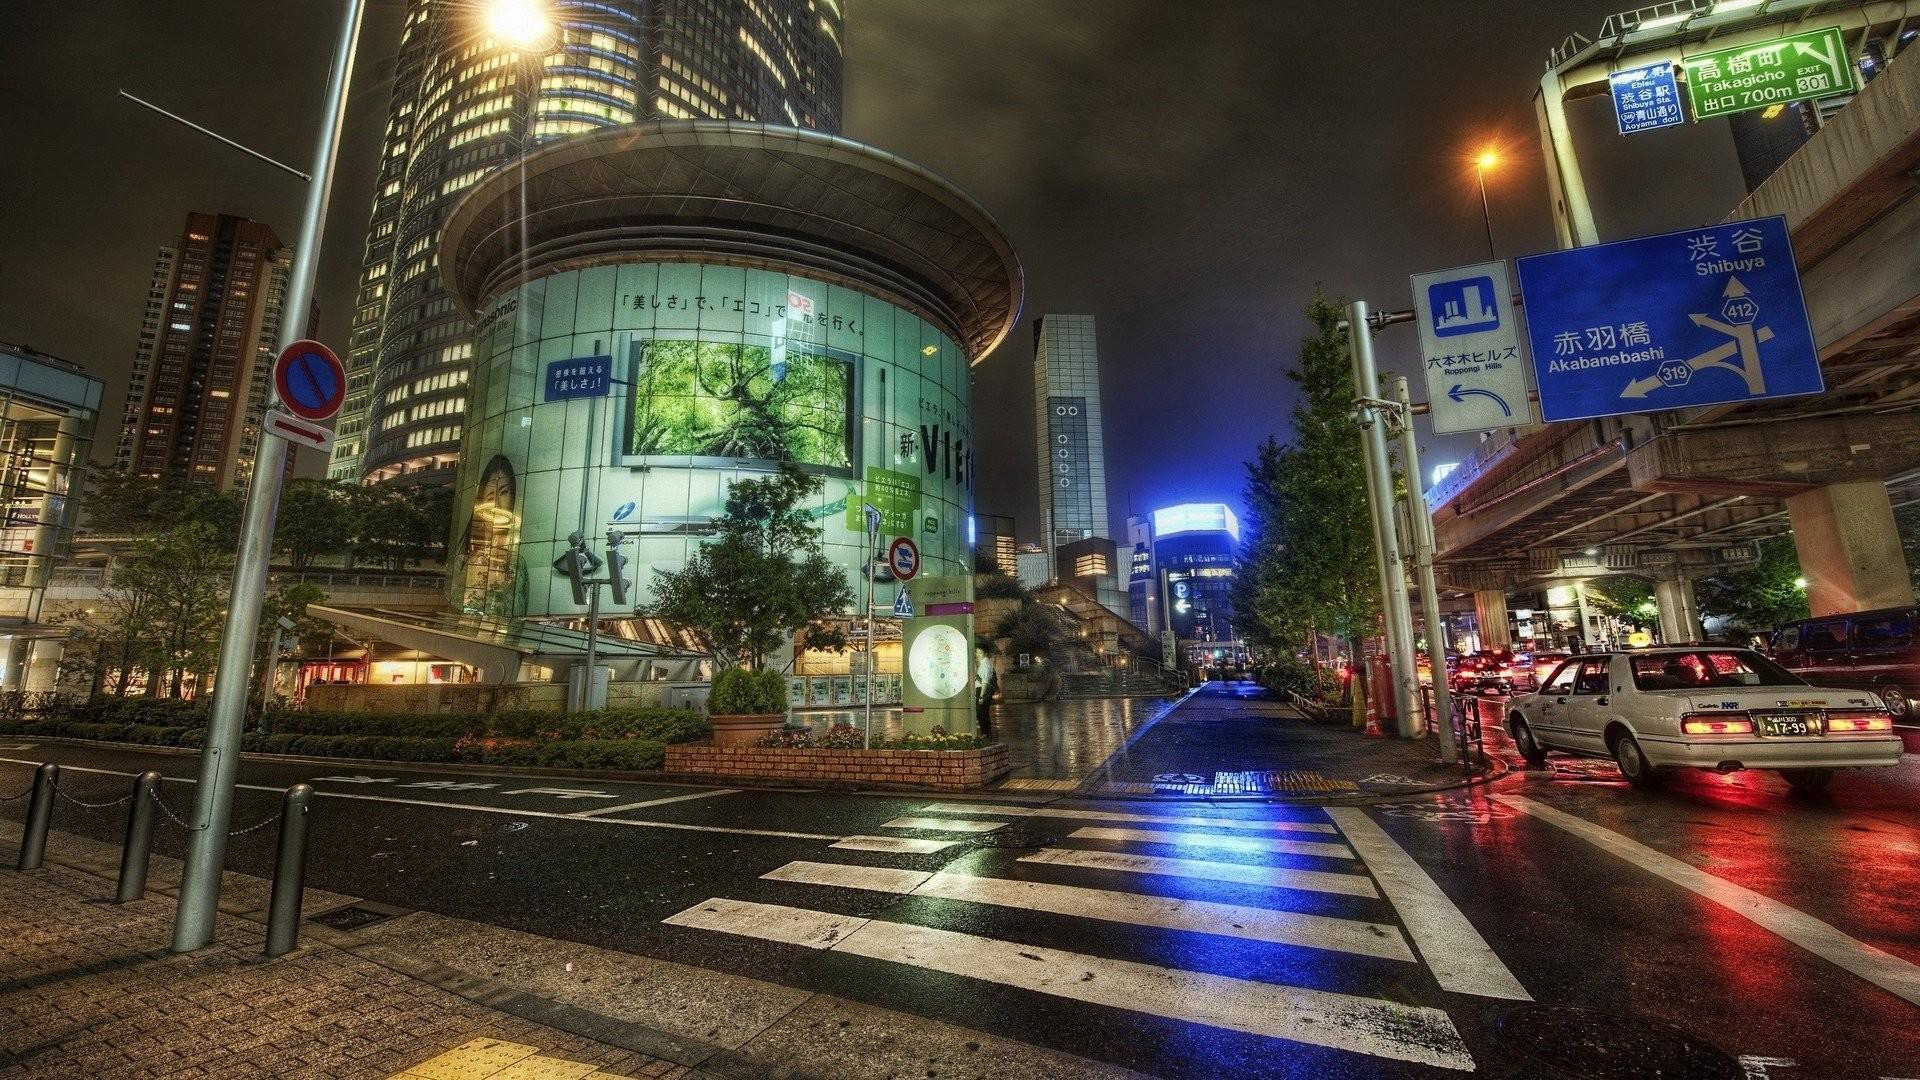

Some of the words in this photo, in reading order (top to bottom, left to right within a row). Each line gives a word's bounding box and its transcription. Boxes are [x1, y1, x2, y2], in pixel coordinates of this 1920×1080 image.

[1797, 64, 1821, 75] EXIT
[1631, 80, 1655, 89] Ebisu
[1701, 70, 1786, 93] Takagicho
[1799, 75, 1829, 92] 301
[1621, 85, 1671, 105] 渋谷駅
[1704, 95, 1735, 112] 出口
[1740, 86, 1792, 105] 700m
[1623, 101, 1654, 111] Shibuya
[1636, 104, 1677, 121] 青山通り
[1625, 119, 1658, 130] Aoyama
[1662, 115, 1679, 123] dori
[1687, 228, 1764, 261] 渋谷
[1695, 257, 1765, 276] Shibuya
[1727, 303, 1754, 318] 412
[1554, 321, 1651, 356] 赤羽橋
[1427, 346, 1519, 370] 六本木ヒルズ
[1548, 346, 1665, 373] Akabanebashi
[1444, 365, 1480, 376] Roppongi
[1485, 362, 1503, 370] Hills
[1662, 365, 1687, 381] 319
